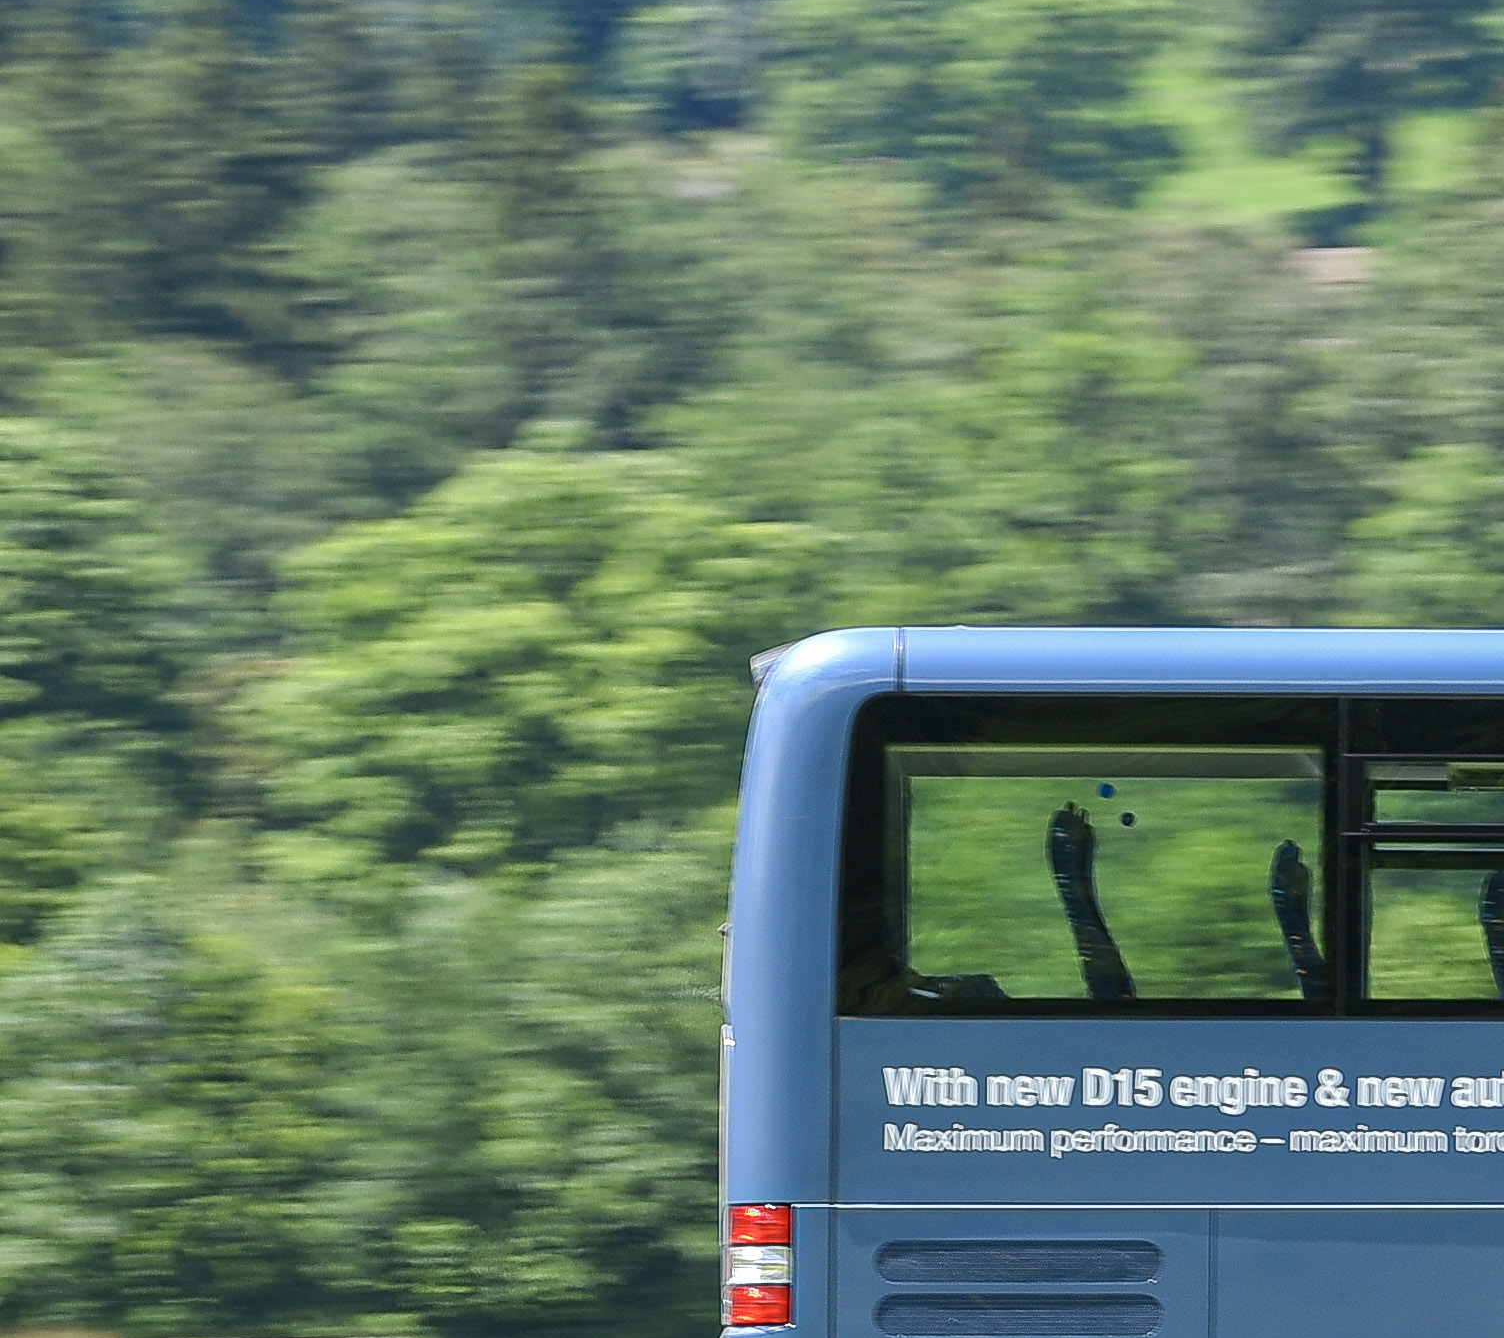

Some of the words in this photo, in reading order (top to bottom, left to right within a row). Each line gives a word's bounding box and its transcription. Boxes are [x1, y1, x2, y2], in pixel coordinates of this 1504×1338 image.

[882, 1067, 978, 1107] With
[986, 1075, 1076, 1107] new
[1082, 1067, 1163, 1107] D15
[1169, 1068, 1309, 1116] engine
[1314, 1068, 1351, 1107] &
[1356, 1076, 1446, 1108] new
[883, 1123, 1045, 1152] Maximum
[1050, 1123, 1258, 1159] performance
[1289, 1124, 1449, 1153] maximum
